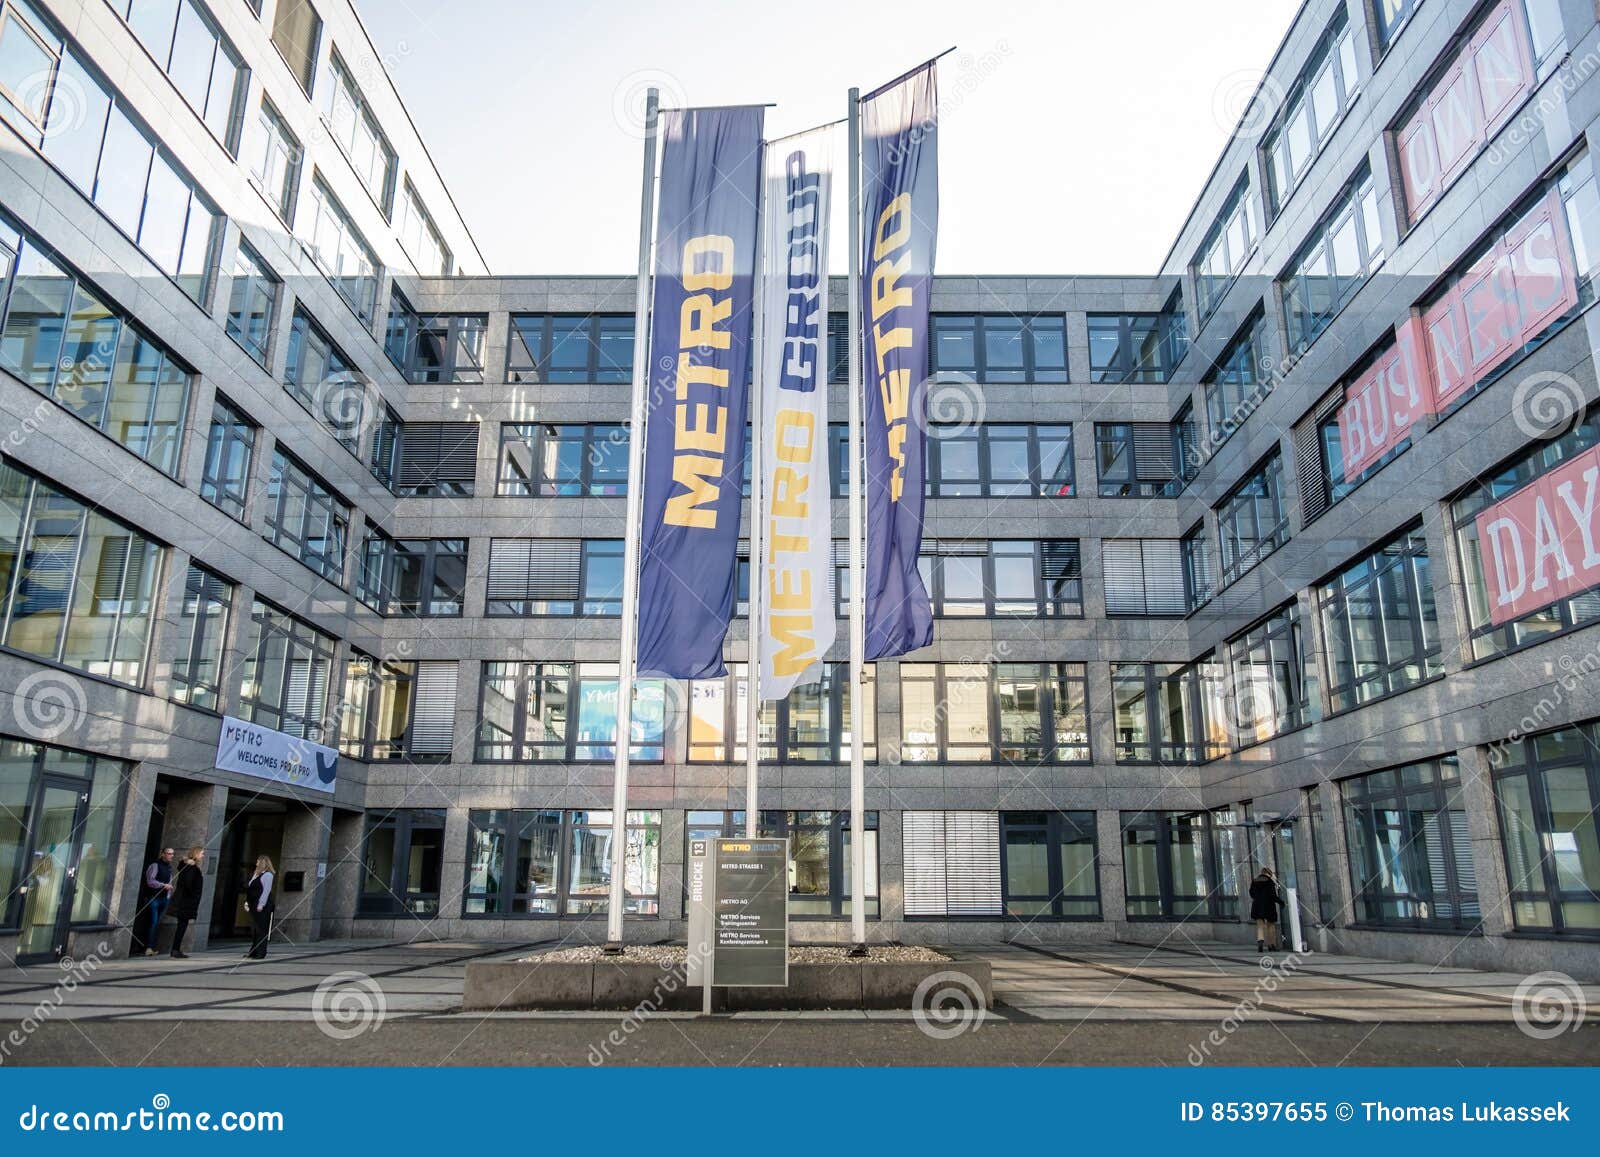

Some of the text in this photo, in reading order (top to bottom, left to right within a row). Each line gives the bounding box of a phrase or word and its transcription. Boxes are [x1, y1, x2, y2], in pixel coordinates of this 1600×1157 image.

[1408, 11, 1525, 198] OWN
[664, 234, 735, 530] METRO
[769, 150, 820, 678] METRO GROUP
[1487, 465, 1600, 606] DAY
[226, 727, 263, 746] METRO
[237, 749, 278, 769] WELCOMES
[694, 843, 704, 855] 13
[722, 843, 752, 852] METRO
